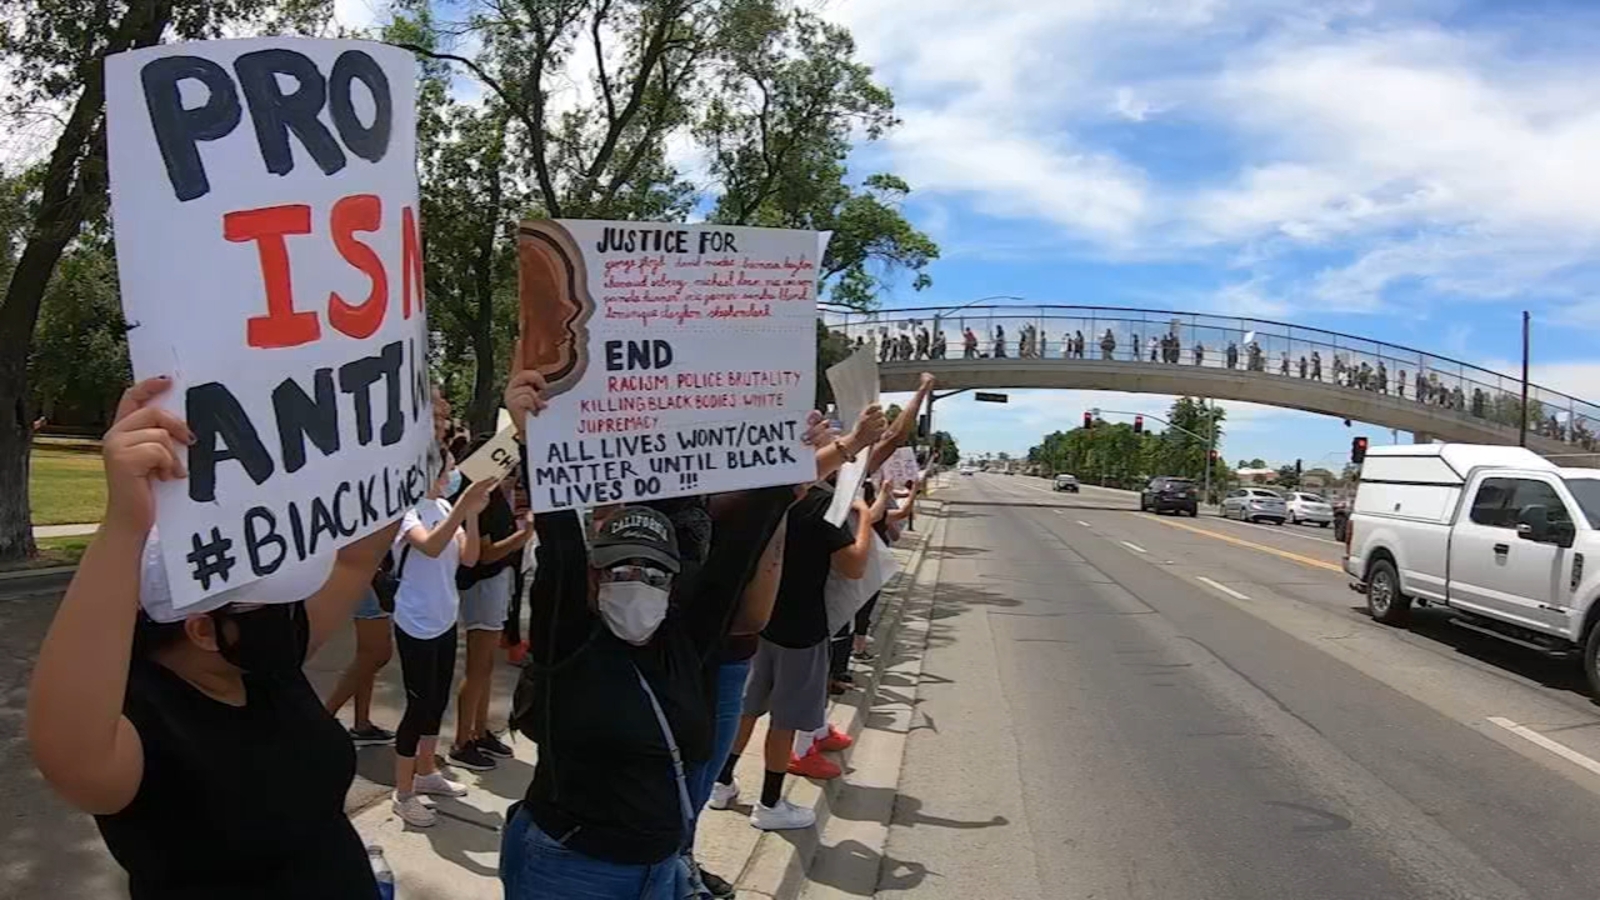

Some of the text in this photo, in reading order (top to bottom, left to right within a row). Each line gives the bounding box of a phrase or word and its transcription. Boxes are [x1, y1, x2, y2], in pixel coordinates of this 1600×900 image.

[140, 48, 393, 202] PRO
[597, 227, 738, 254] JUSTICE FOR
[605, 340, 673, 371] END
[608, 371, 801, 392] RACISM POLICE BRUTALITY
[580, 397, 646, 413] KILLING
[648, 395, 691, 410] BLACK
[695, 394, 736, 409] BODIES
[186, 340, 404, 503] ANTI
[547, 420, 798, 464] ALL LIVES WONT/CANT
[536, 445, 797, 486] MATTER UNTIL BLACK
[550, 481, 623, 508] LIVES
[634, 476, 661, 496] DO
